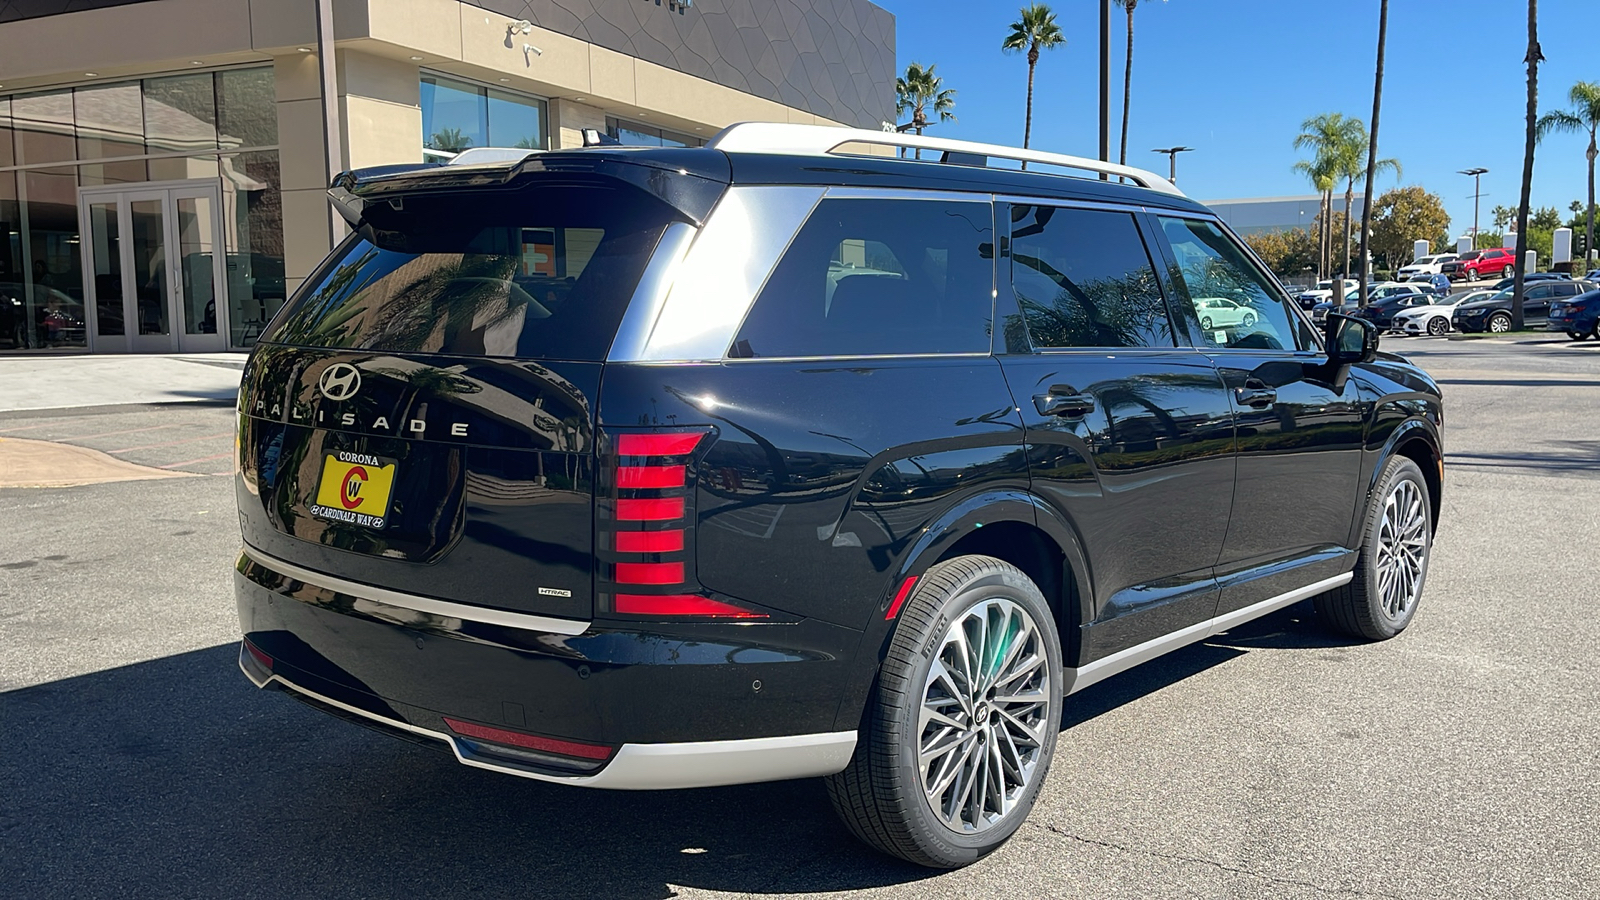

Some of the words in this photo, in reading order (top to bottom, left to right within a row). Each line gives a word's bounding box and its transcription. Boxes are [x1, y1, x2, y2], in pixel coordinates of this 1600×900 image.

[256, 400, 469, 437] PALISADE
[340, 451, 379, 466] CORONA
[340, 466, 369, 510] C
[348, 480, 362, 498] W
[319, 506, 356, 523] CARDINALE
[357, 514, 374, 526] WAY
[540, 588, 570, 596] HTRAC
[920, 613, 948, 660] PIRELLI
[913, 806, 960, 857] SCORPION
